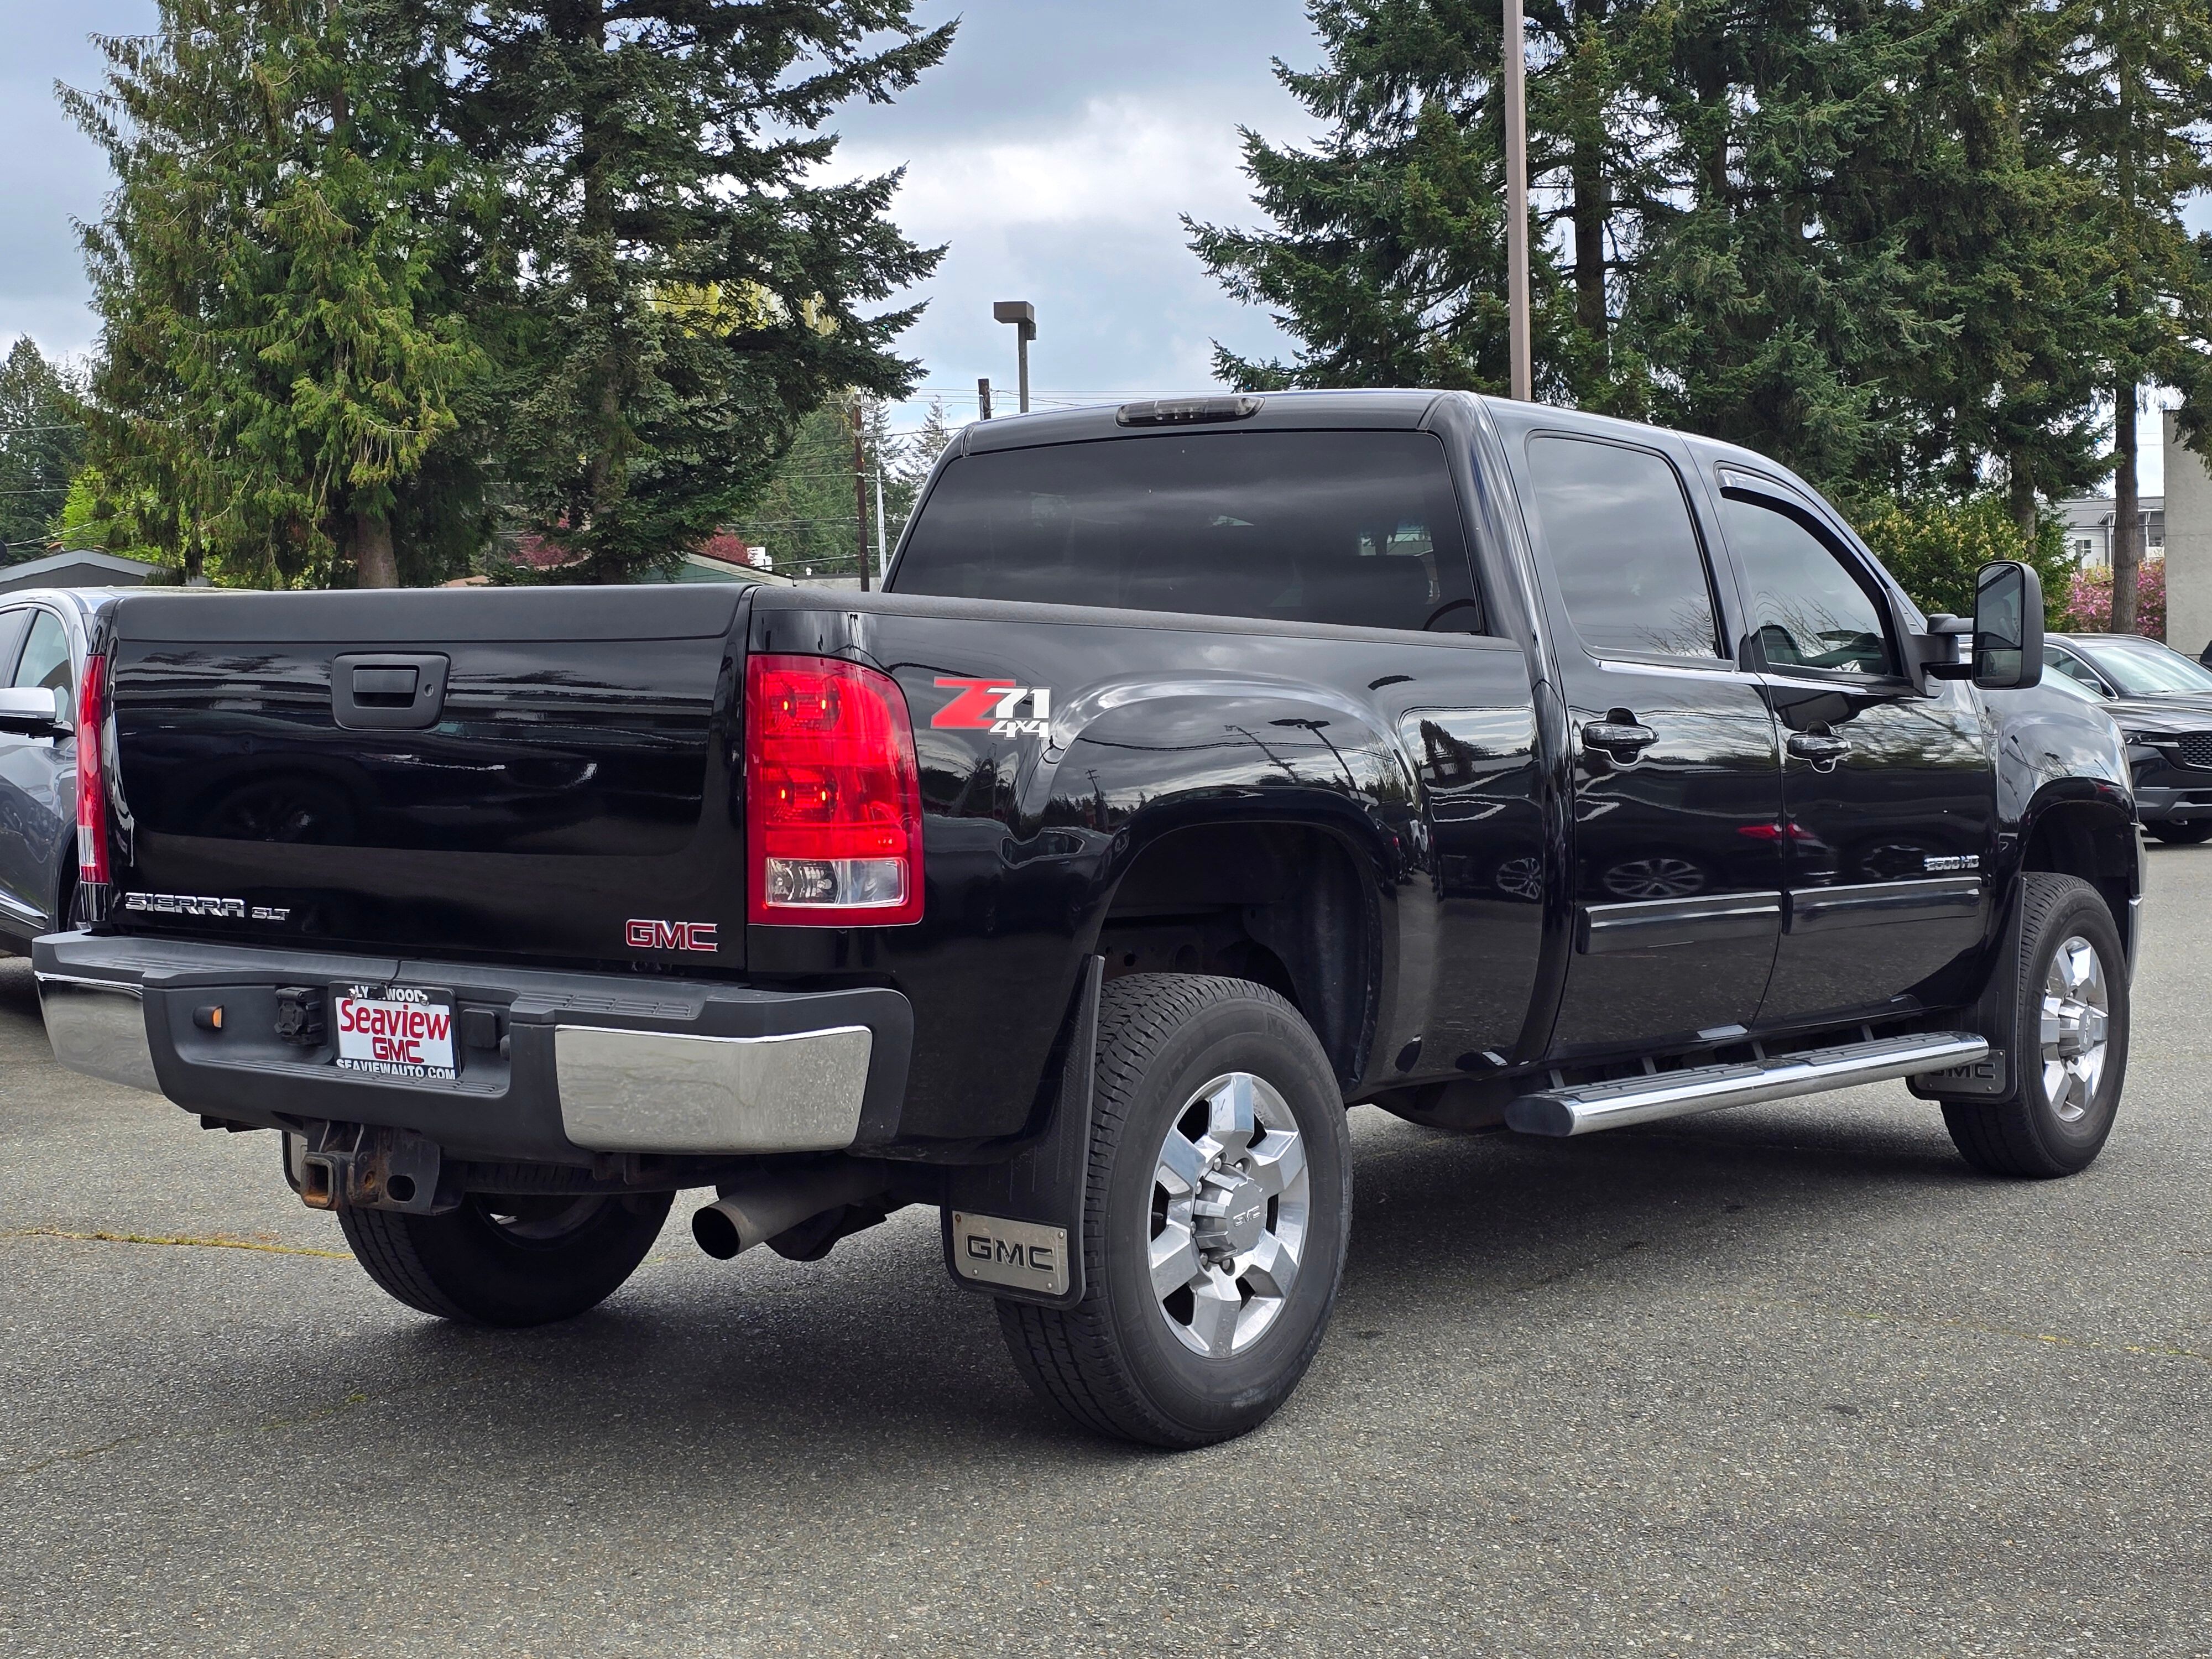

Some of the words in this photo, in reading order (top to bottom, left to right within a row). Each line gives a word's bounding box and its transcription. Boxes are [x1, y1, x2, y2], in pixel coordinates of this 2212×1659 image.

[930, 676, 1051, 729] Z71
[125, 892, 245, 918] SIERRA
[252, 906, 291, 921] SLT
[625, 919, 718, 952] GMC
[340, 999, 451, 1041] Seaview
[372, 1036, 425, 1064] GMC
[966, 1233, 1055, 1274] GMC
